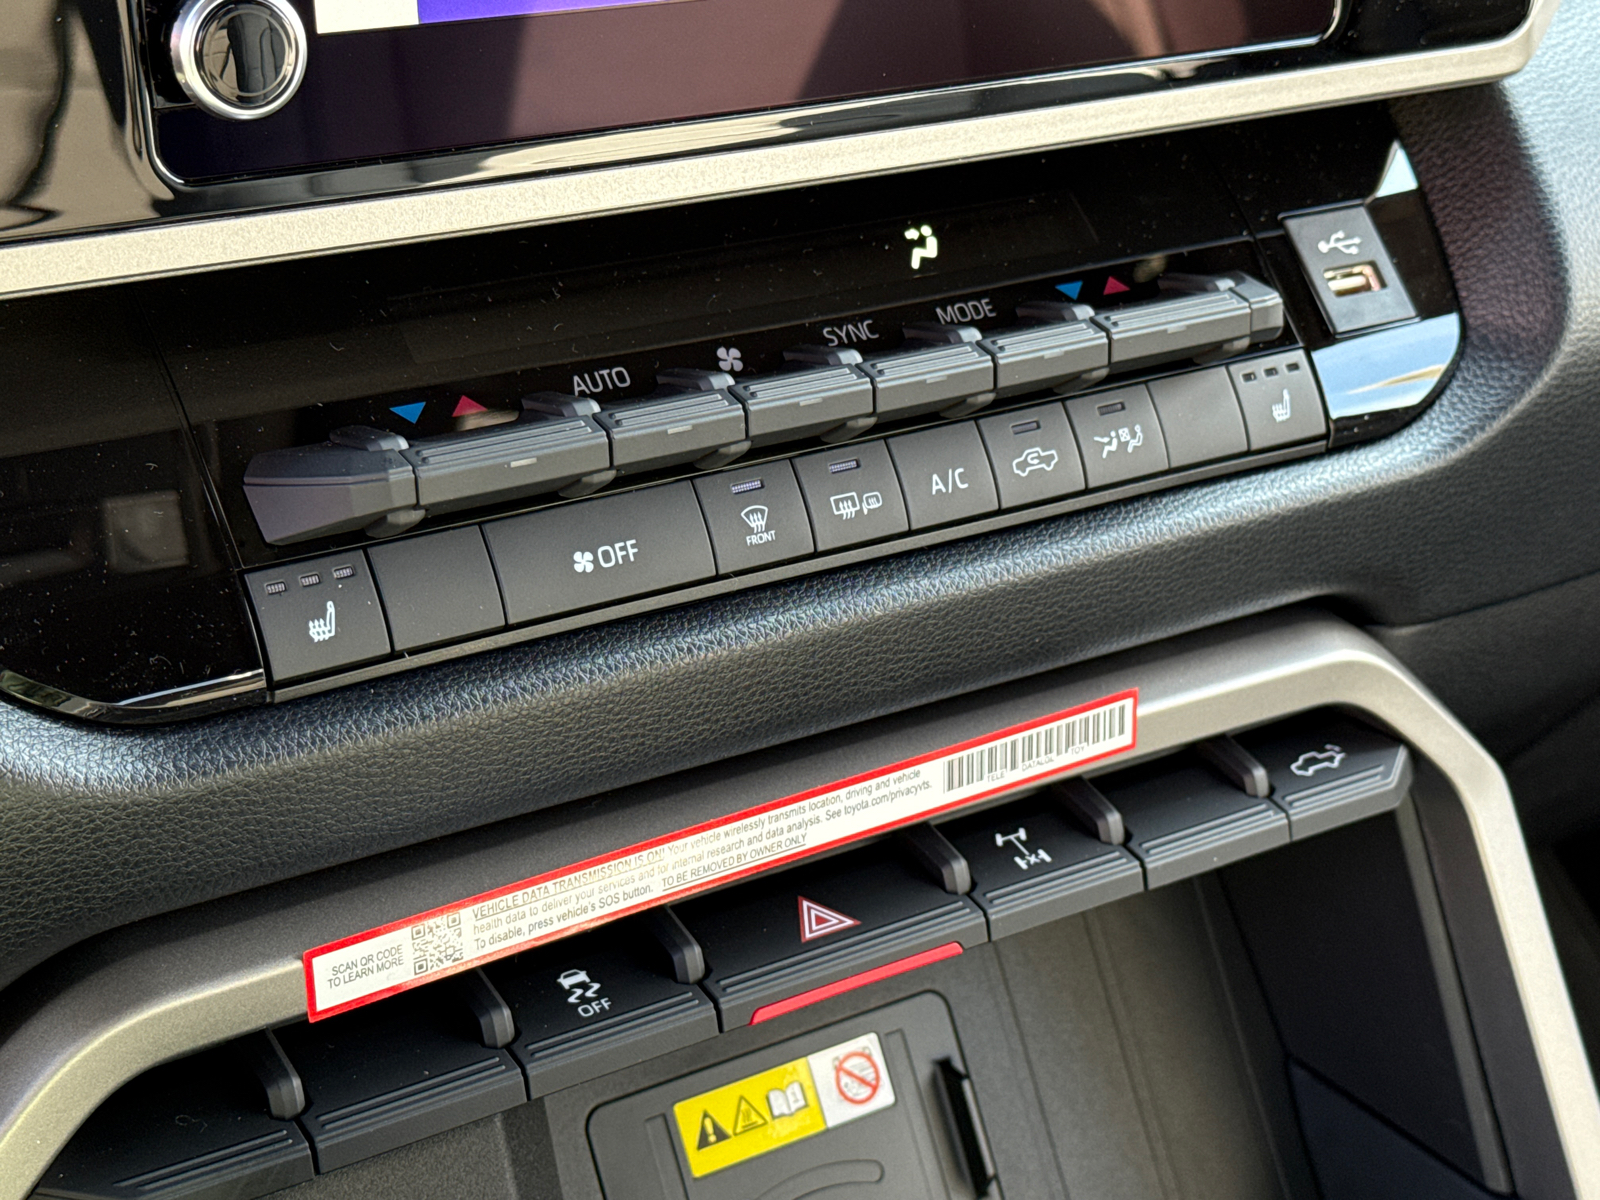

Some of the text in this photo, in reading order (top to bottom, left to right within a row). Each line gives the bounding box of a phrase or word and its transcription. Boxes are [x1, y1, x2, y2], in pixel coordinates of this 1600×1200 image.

[935, 298, 997, 325] MODE
[822, 319, 880, 347] SYNC
[572, 366, 631, 397] AUTO
[931, 467, 969, 495] A/C
[597, 539, 639, 568] OFF
[745, 529, 776, 546] FRONT
[987, 770, 1005, 782] TELE
[1070, 745, 1085, 755] TOY
[472, 769, 921, 919] VEHICLE DATA TRANSMISSION IS ON! Your vehicle wirelessly transmits location, driving and vehicle
[473, 781, 933, 935] health data to deliver your services and for internal research and data analysis. See toyota.com/privacyvts.
[661, 832, 807, 887] TO BE REMOVED BY OWNER ONLY
[474, 884, 654, 951] To disable, press vehicle's SOS button.
[327, 955, 404, 989] TO LEARN MORE
[331, 944, 403, 977] SCAN QR CODE
[577, 997, 612, 1018] OFF
